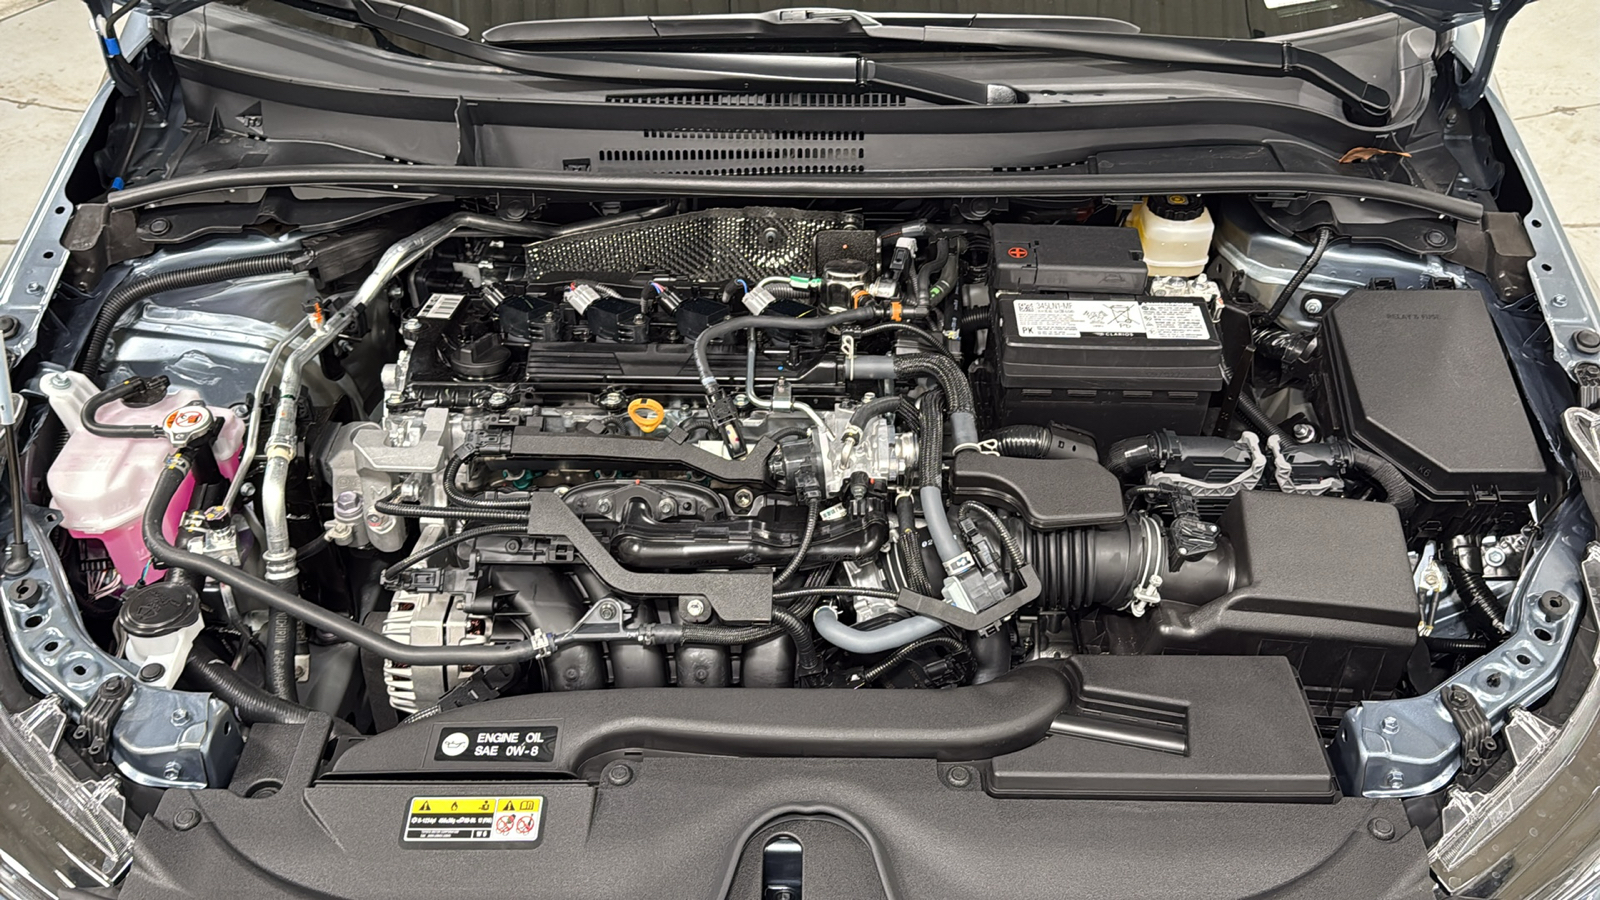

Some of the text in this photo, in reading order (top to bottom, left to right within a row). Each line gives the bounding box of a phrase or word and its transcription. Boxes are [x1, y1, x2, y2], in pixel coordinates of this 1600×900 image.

[1022, 326, 1034, 334] PK
[477, 732, 544, 743] ENGINE OIL
[474, 745, 539, 756] SAE 0W-8
